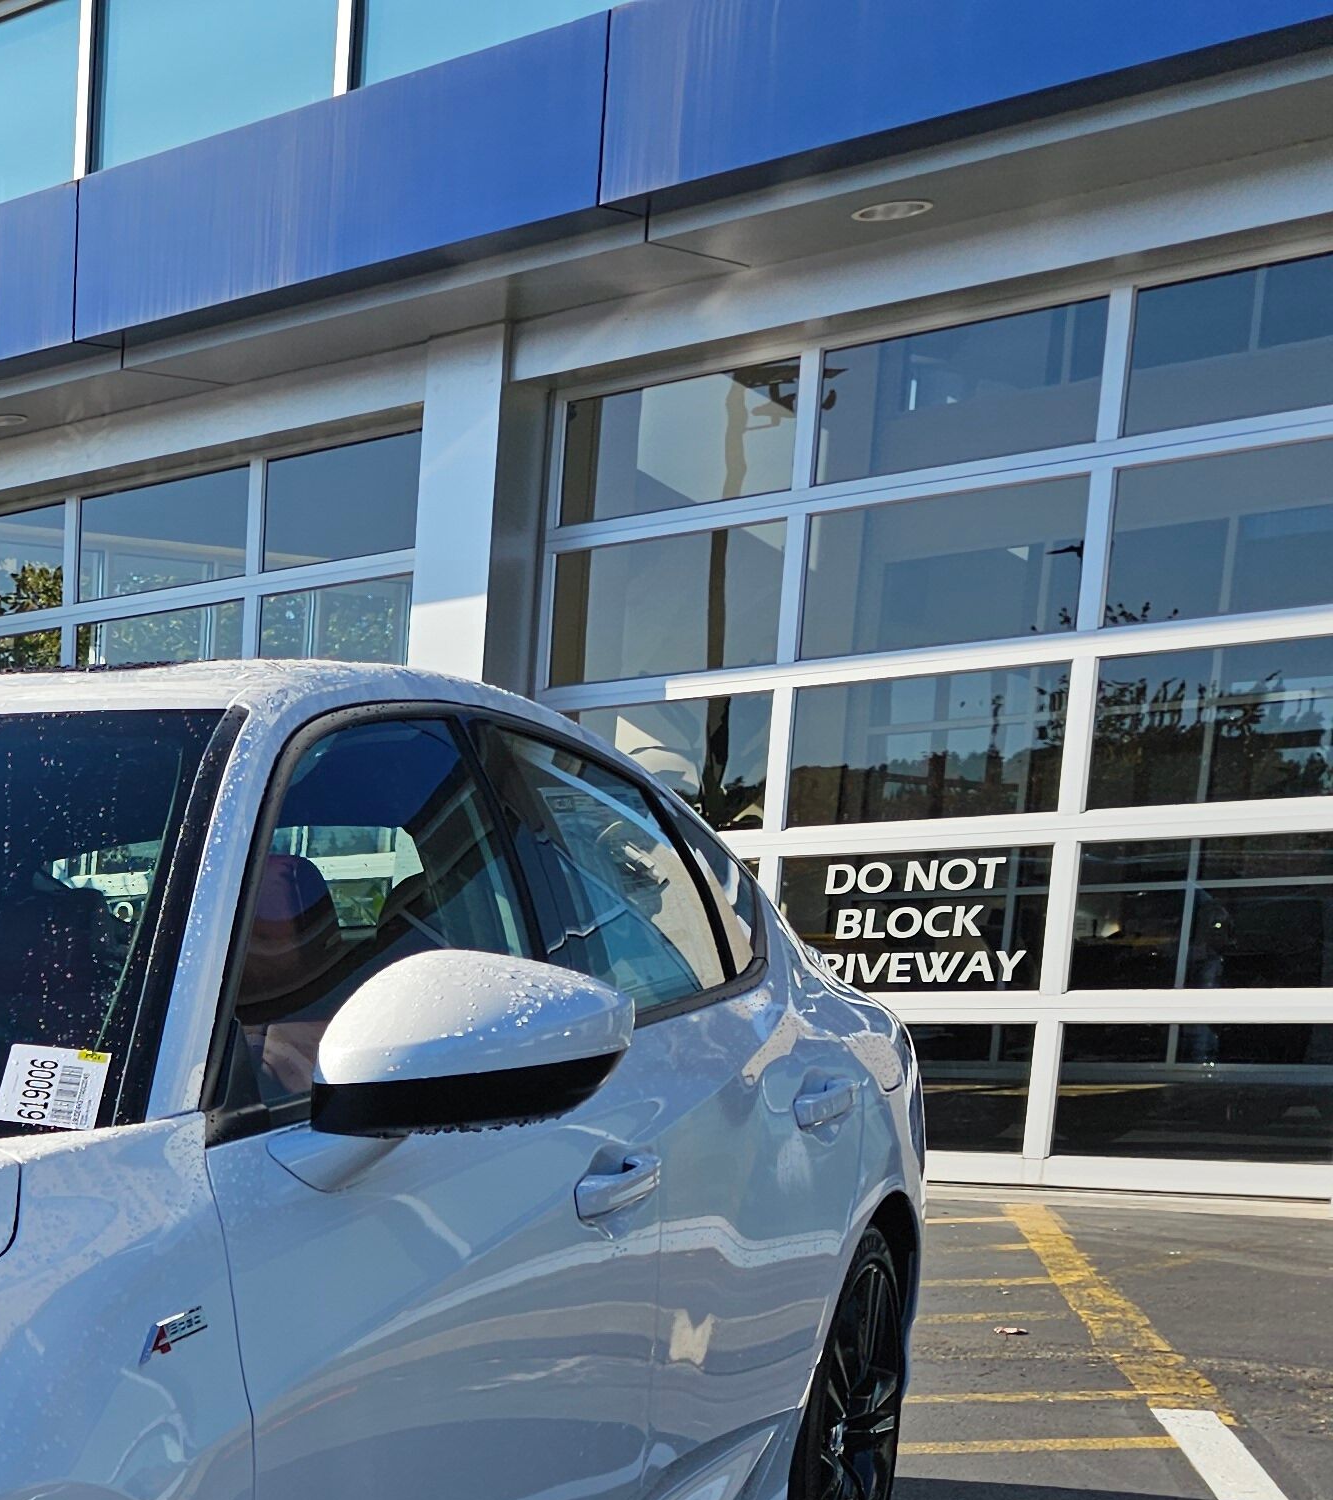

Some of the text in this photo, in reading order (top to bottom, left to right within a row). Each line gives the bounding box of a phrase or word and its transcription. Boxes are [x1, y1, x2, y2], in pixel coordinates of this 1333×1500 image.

[824, 856, 1007, 895] DO NOT
[834, 904, 985, 940] BLOCK
[821, 950, 1027, 984] RIVEWAY
[17, 1059, 59, 1121] 619006
